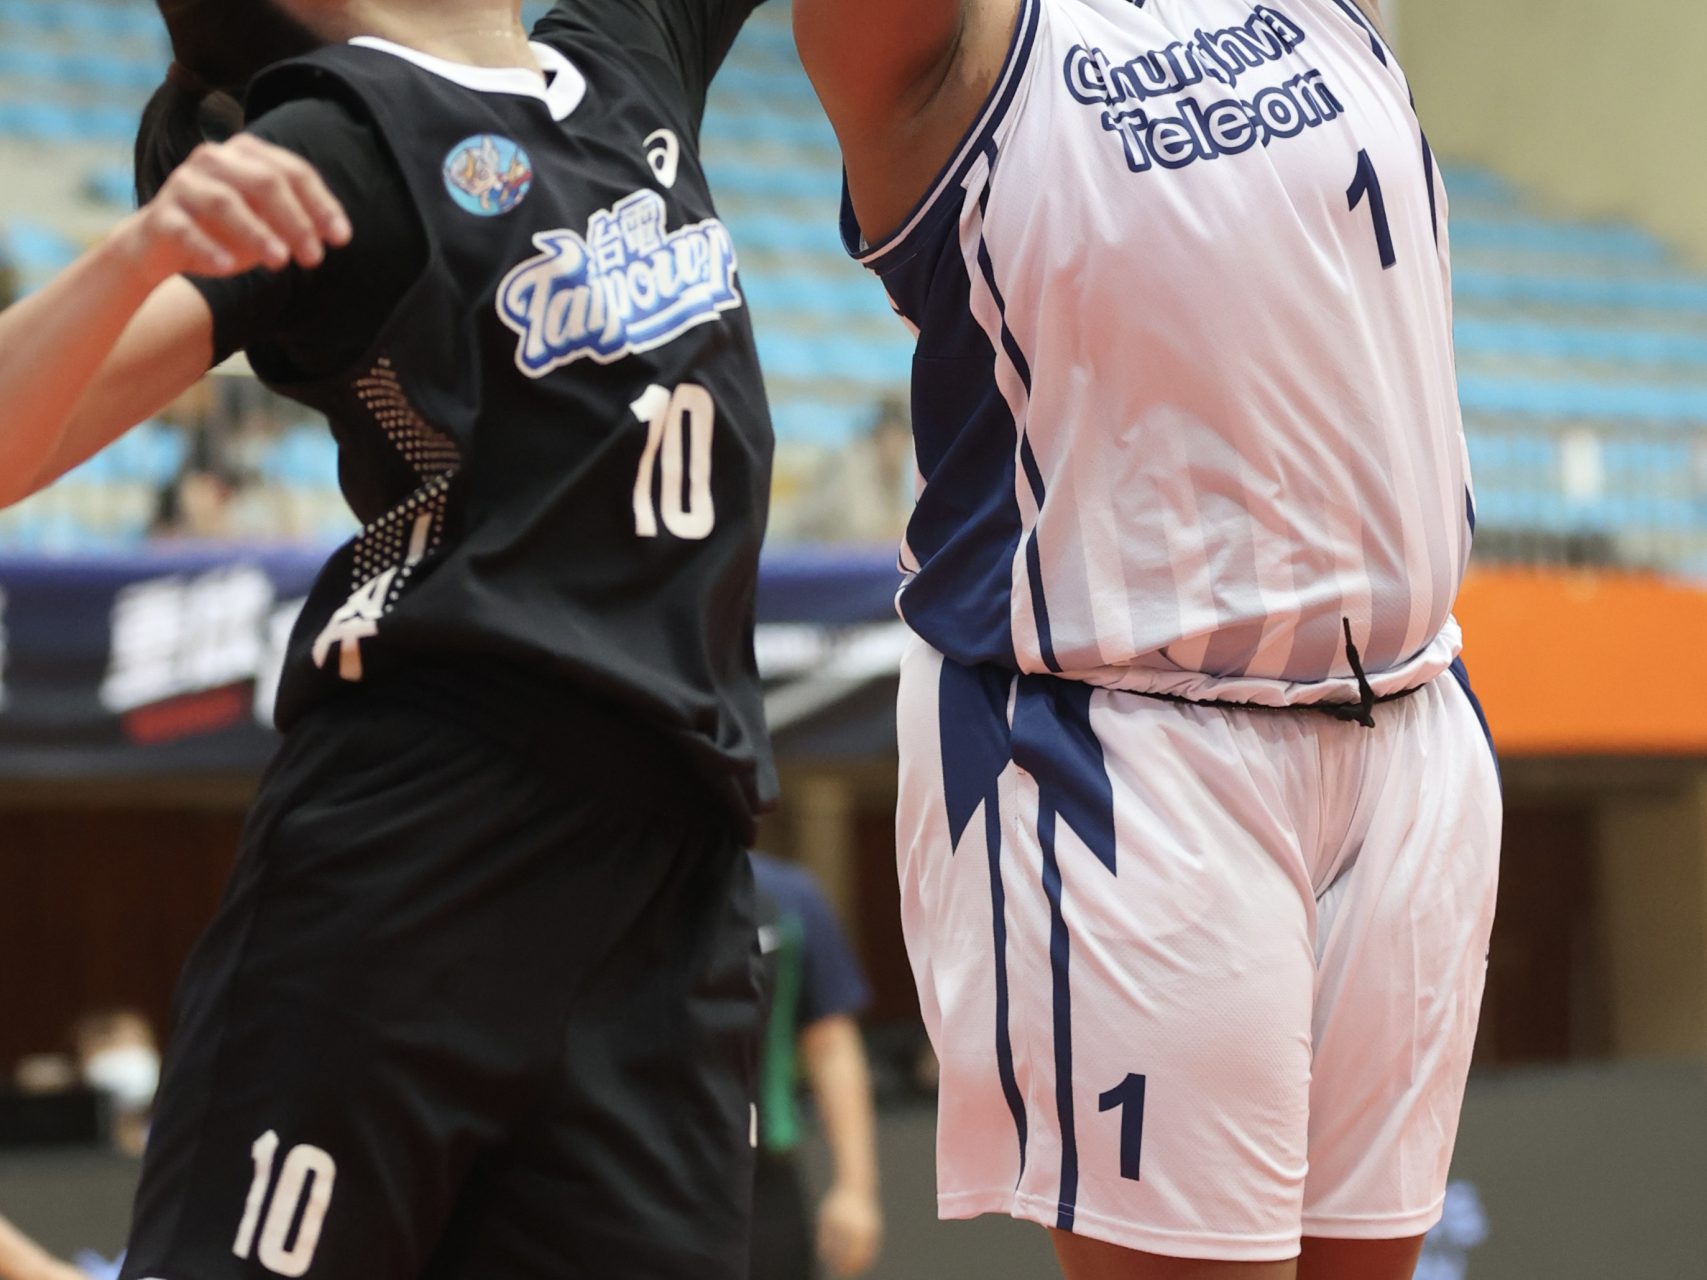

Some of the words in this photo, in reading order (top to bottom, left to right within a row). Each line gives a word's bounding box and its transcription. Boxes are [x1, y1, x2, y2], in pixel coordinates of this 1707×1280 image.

[1346, 147, 1396, 271] 1
[630, 383, 715, 540] 10
[1098, 1072, 1146, 1182] 1
[232, 1129, 336, 1278] 10
